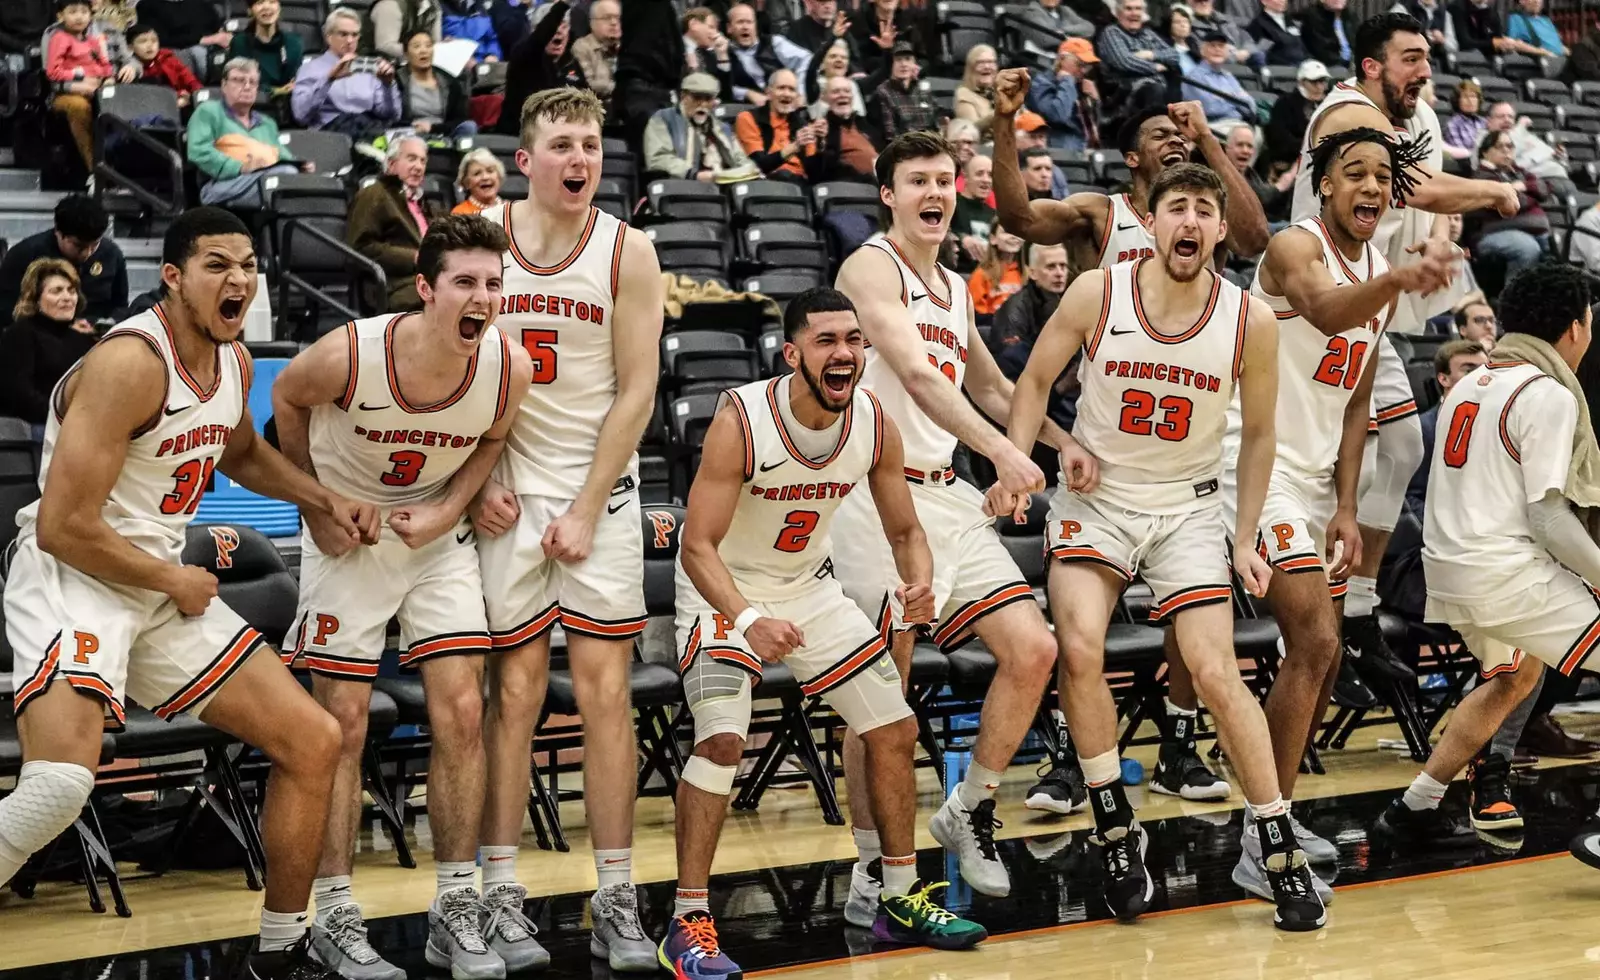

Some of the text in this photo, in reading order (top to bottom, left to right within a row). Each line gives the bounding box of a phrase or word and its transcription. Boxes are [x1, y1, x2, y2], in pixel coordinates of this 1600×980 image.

[499, 293, 605, 326] RINCETON
[521, 328, 558, 385] 5
[1312, 335, 1368, 391] 20
[1104, 360, 1221, 393] PRINCETON
[1118, 388, 1194, 442] 23
[155, 424, 232, 458] PRINCETO
[1443, 400, 1480, 469] 0
[380, 449, 427, 487] 3
[750, 481, 857, 501] PRINCETO
[645, 510, 676, 548] P
[773, 509, 820, 553] 2
[1059, 519, 1082, 540] P
[1271, 523, 1294, 552] P
[208, 526, 240, 569] P
[312, 612, 340, 646] P
[712, 613, 735, 640] P
[73, 630, 100, 665] P
